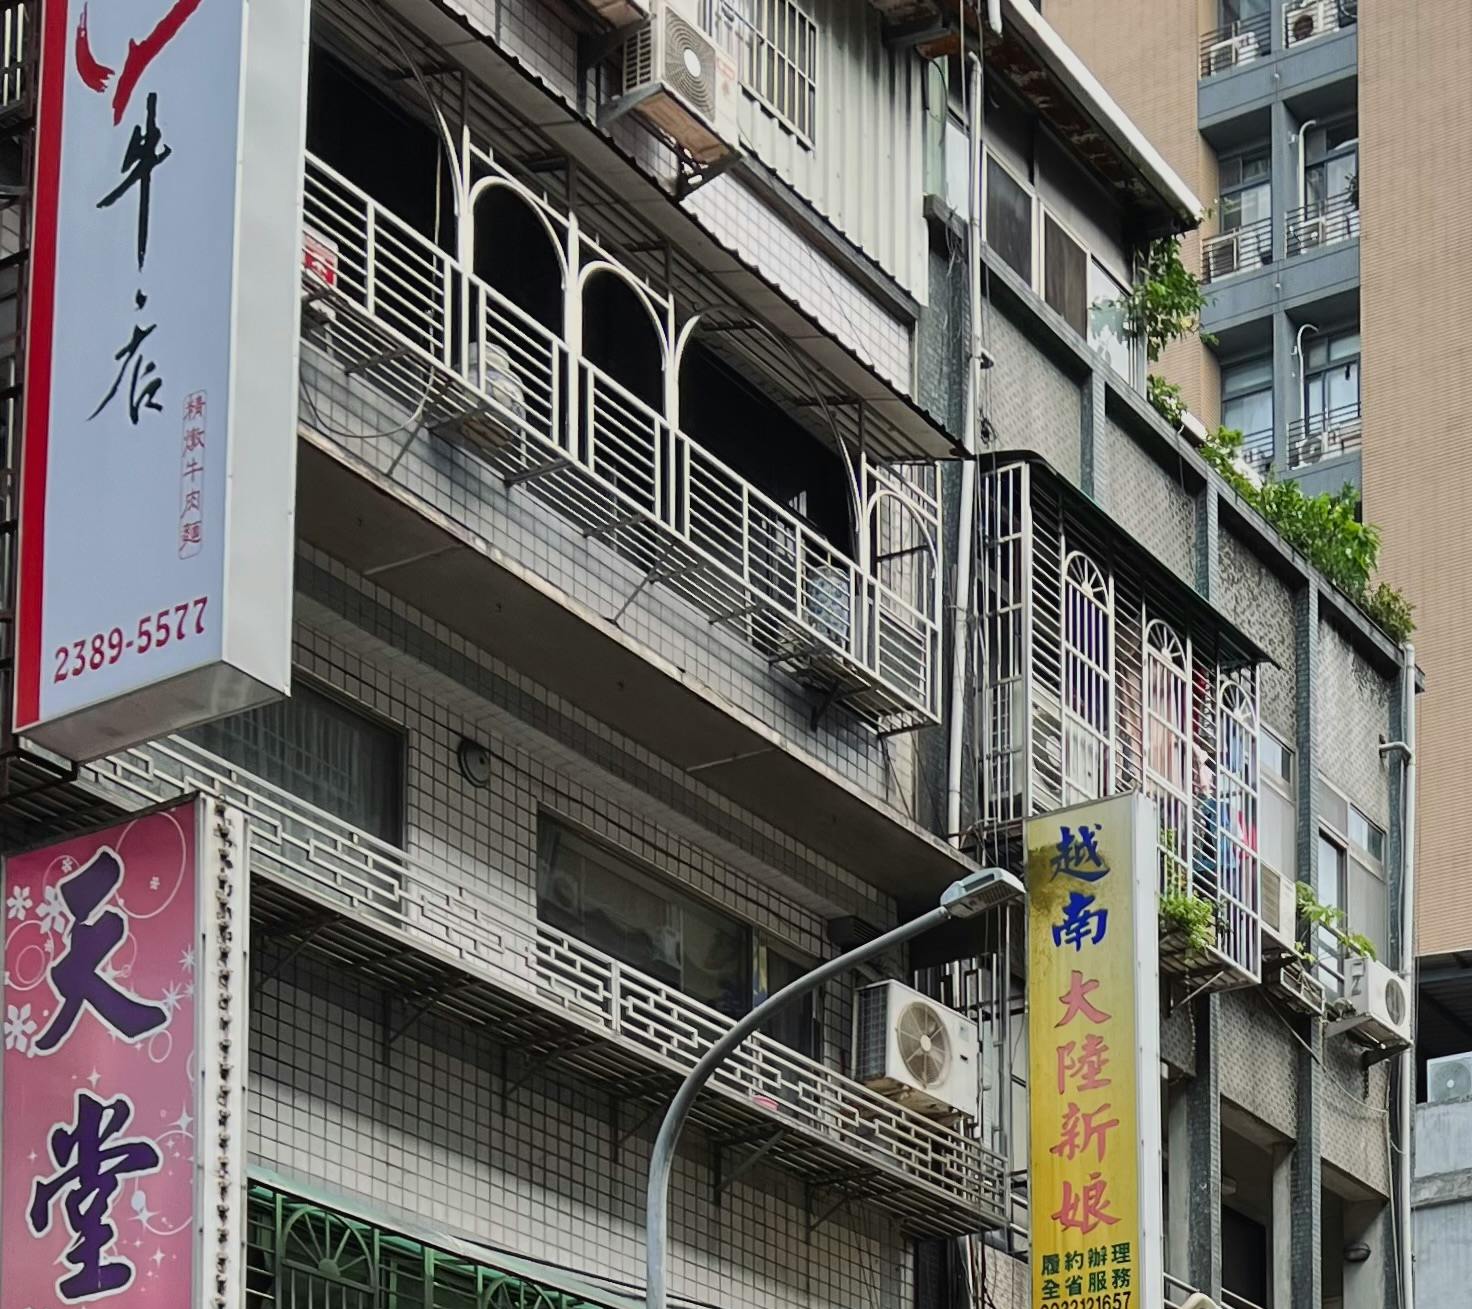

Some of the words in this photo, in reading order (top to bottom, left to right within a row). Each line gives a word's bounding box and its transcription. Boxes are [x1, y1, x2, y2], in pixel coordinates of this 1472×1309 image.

[55, 596, 209, 685] 2389-5577
[1049, 824, 1111, 952] 越南
[27, 846, 171, 1304] 天堂
[1049, 970, 1122, 1235] 大陸新娘
[1041, 1267, 1131, 1300] 全省服務
